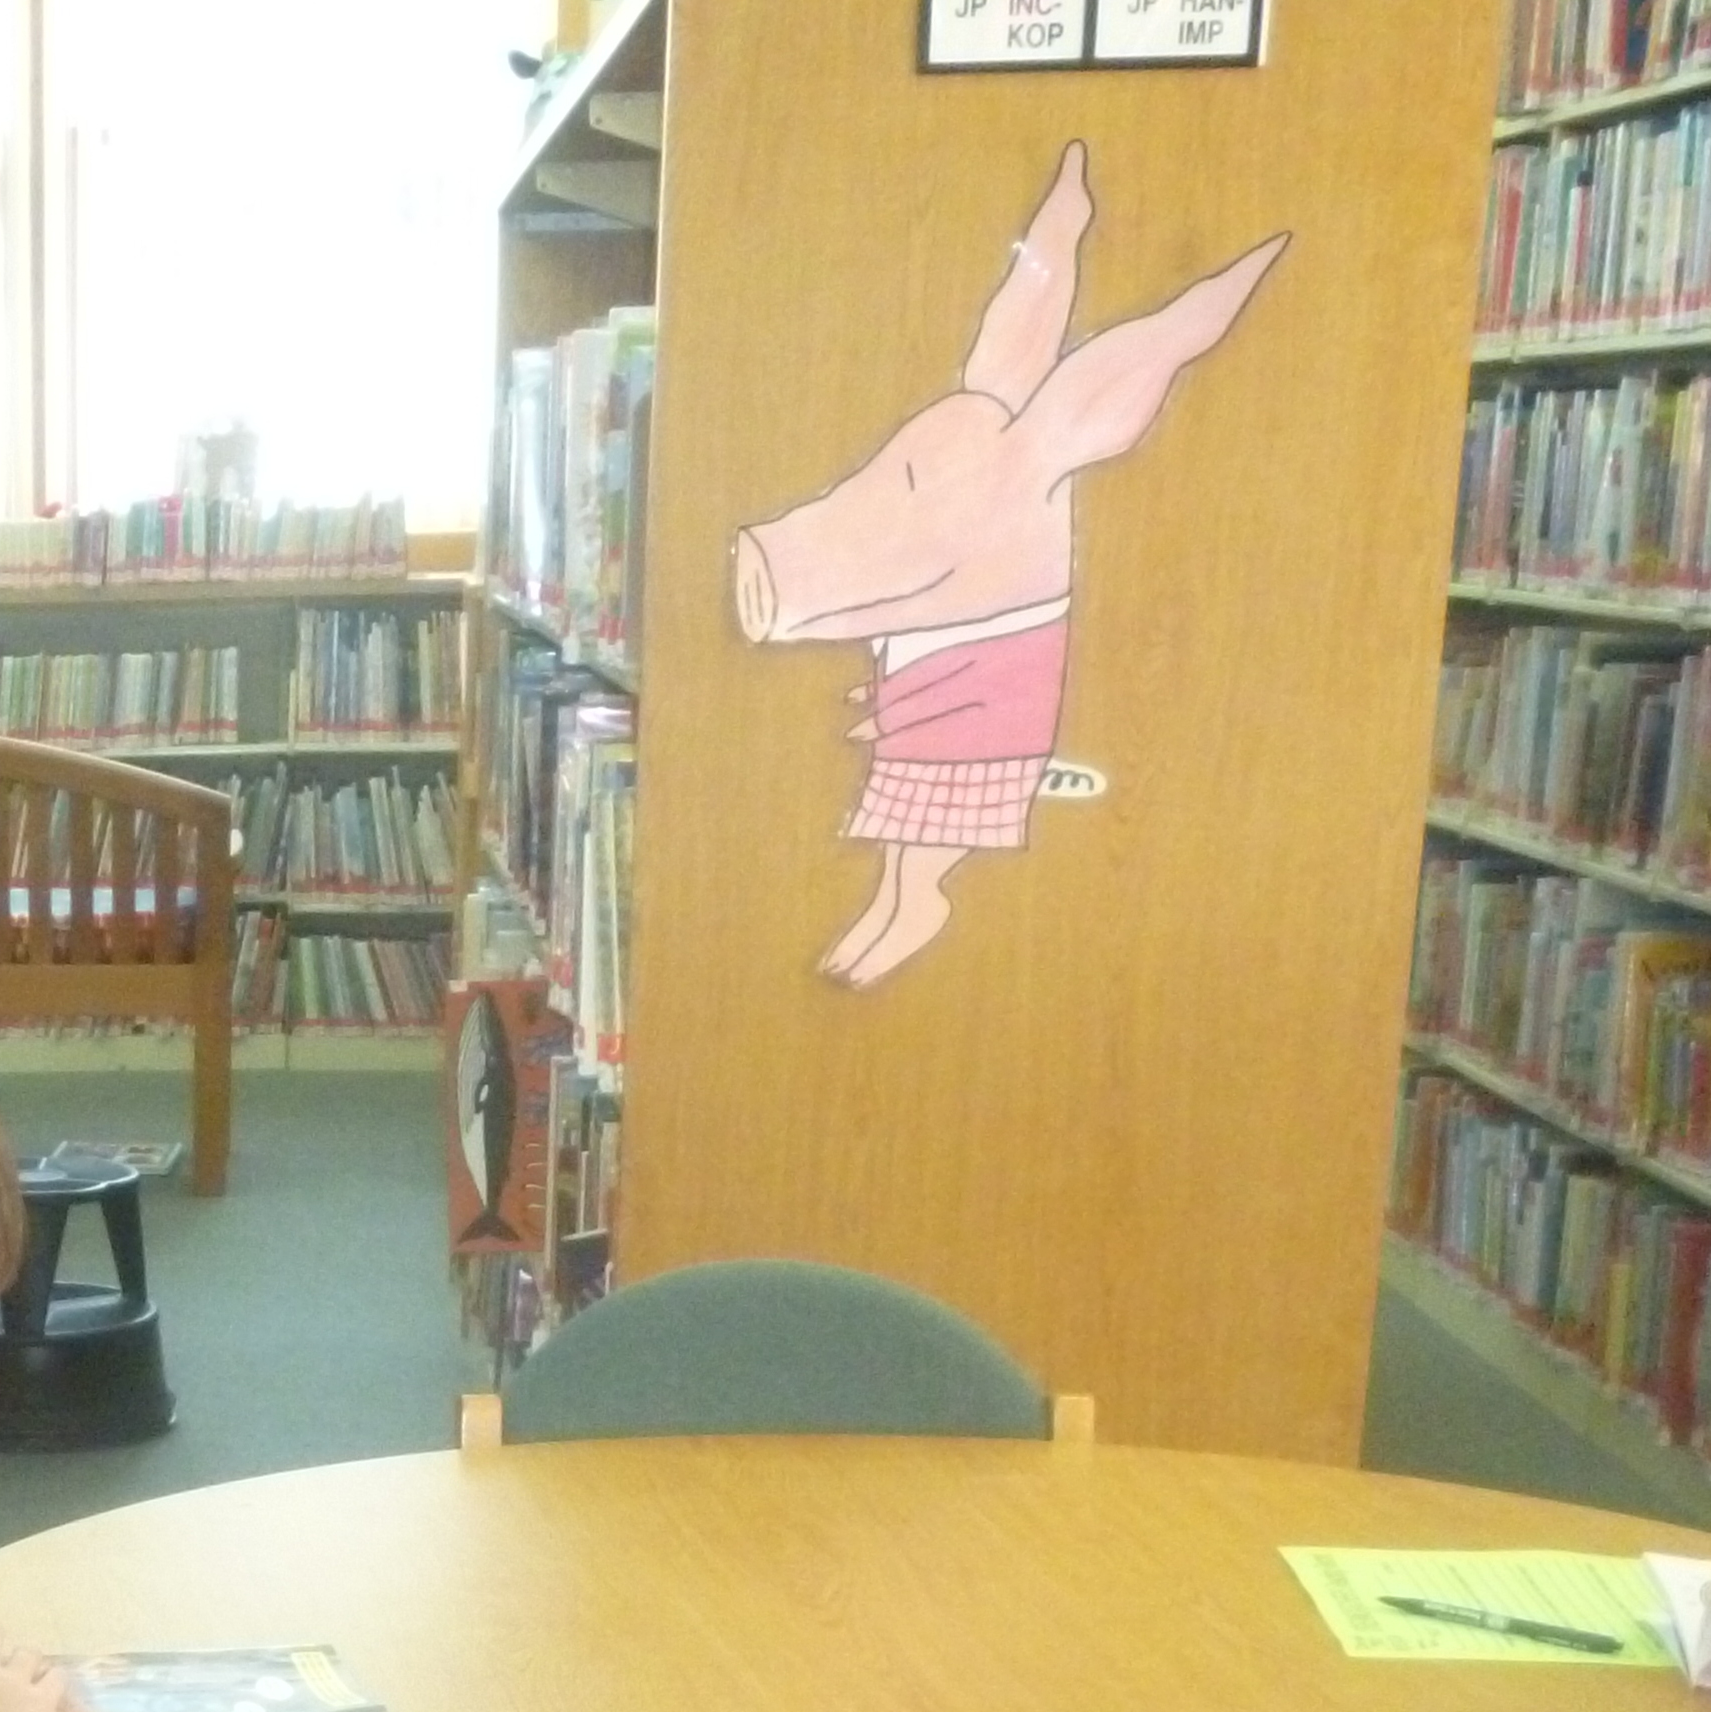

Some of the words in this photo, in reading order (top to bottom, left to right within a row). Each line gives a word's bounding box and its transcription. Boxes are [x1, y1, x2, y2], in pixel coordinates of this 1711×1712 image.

[955, 0, 986, 18] JP
[1127, 0, 1158, 14] JP
[1007, 22, 1064, 49] KOP
[1178, 20, 1224, 45] IMP
